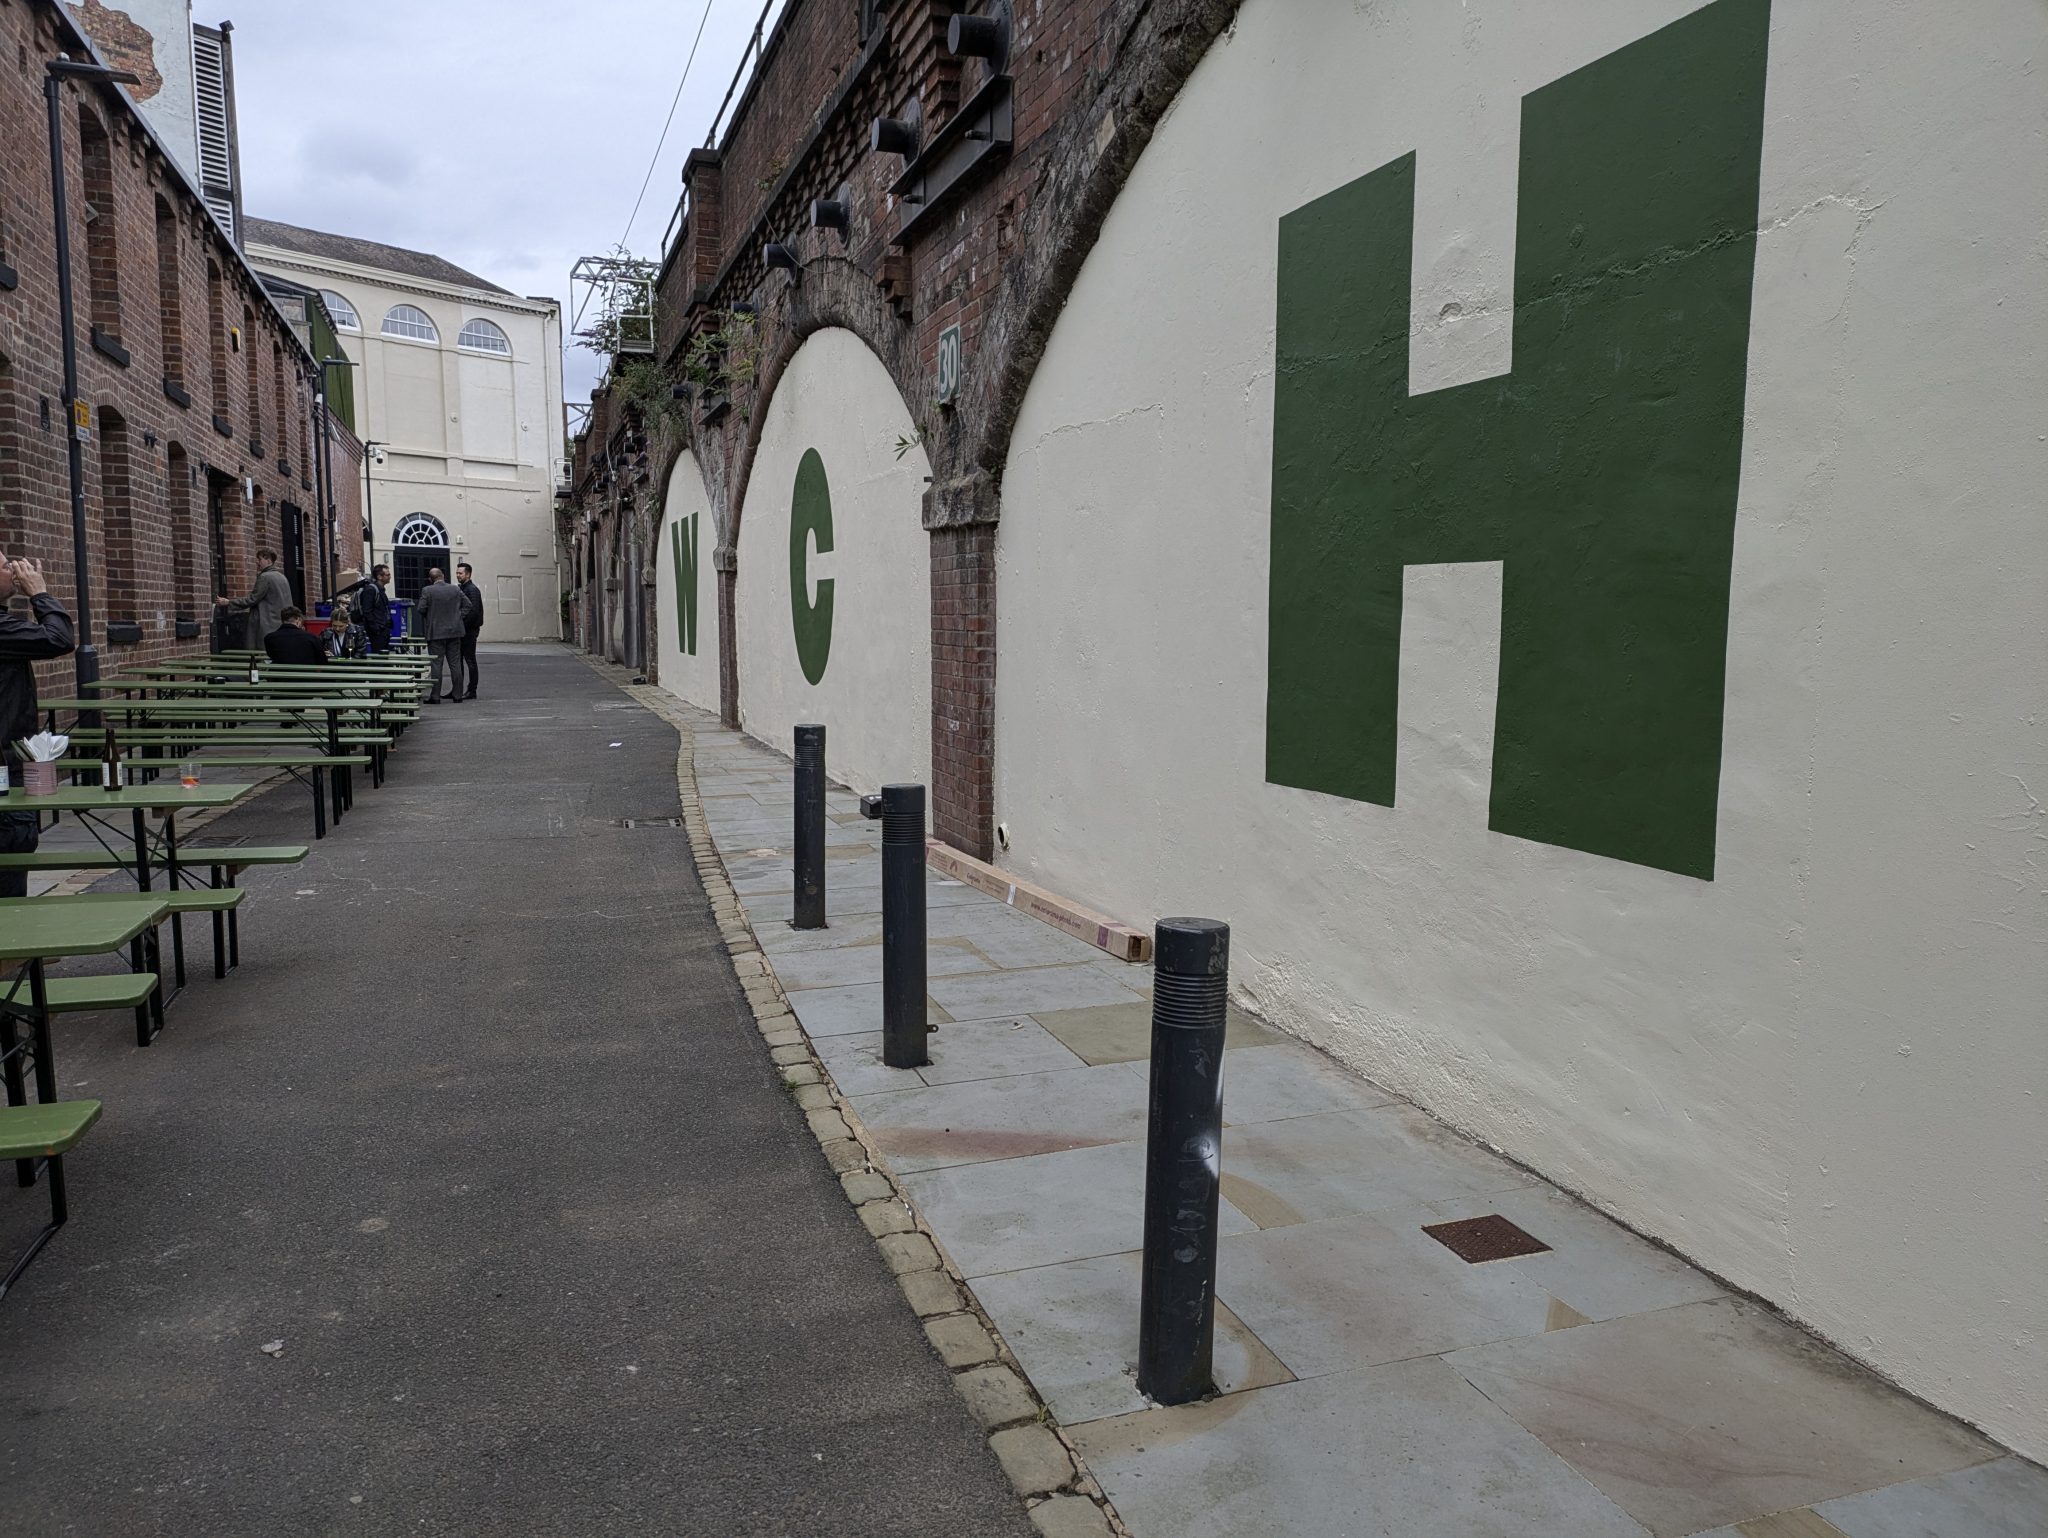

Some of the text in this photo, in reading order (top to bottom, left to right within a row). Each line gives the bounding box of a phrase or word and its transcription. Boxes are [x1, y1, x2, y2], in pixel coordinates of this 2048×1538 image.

[941, 334, 957, 394] 30
[1266, 0, 1771, 881] H
[671, 512, 698, 656] W
[790, 447, 834, 686] C
